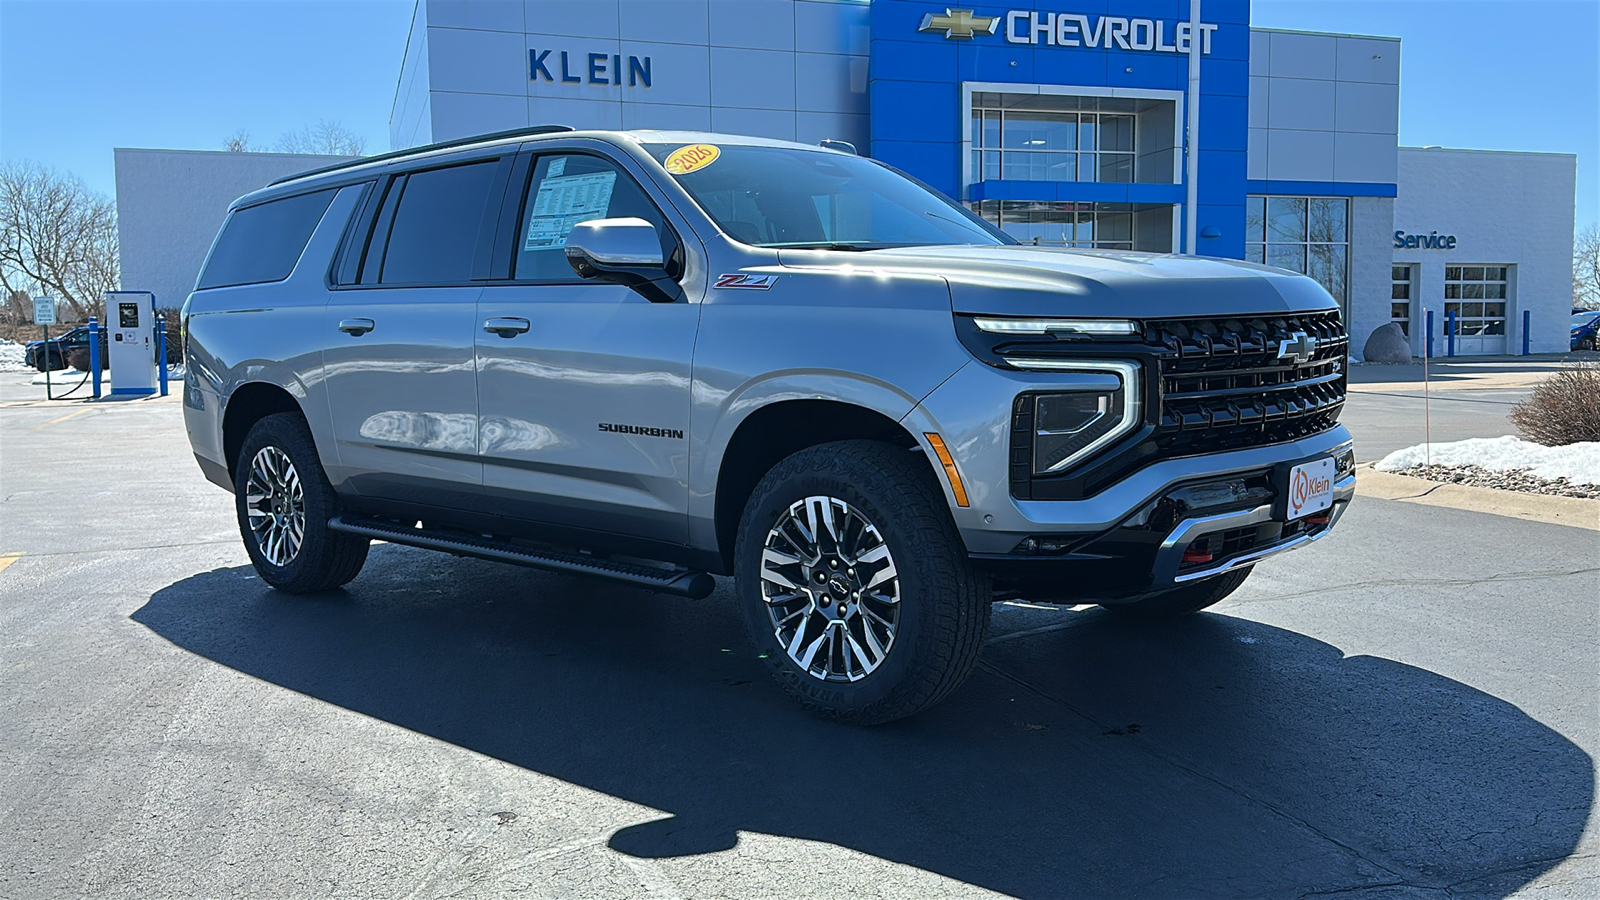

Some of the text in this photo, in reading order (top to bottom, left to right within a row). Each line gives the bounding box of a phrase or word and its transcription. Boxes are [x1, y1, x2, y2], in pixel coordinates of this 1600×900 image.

[1006, 10, 1218, 54] CHEVROLET
[528, 48, 652, 88] KLEIN
[674, 146, 712, 170] 2026
[1393, 230, 1457, 249] Service
[598, 422, 684, 439] SUBURBAN
[1308, 475, 1330, 496] Klein
